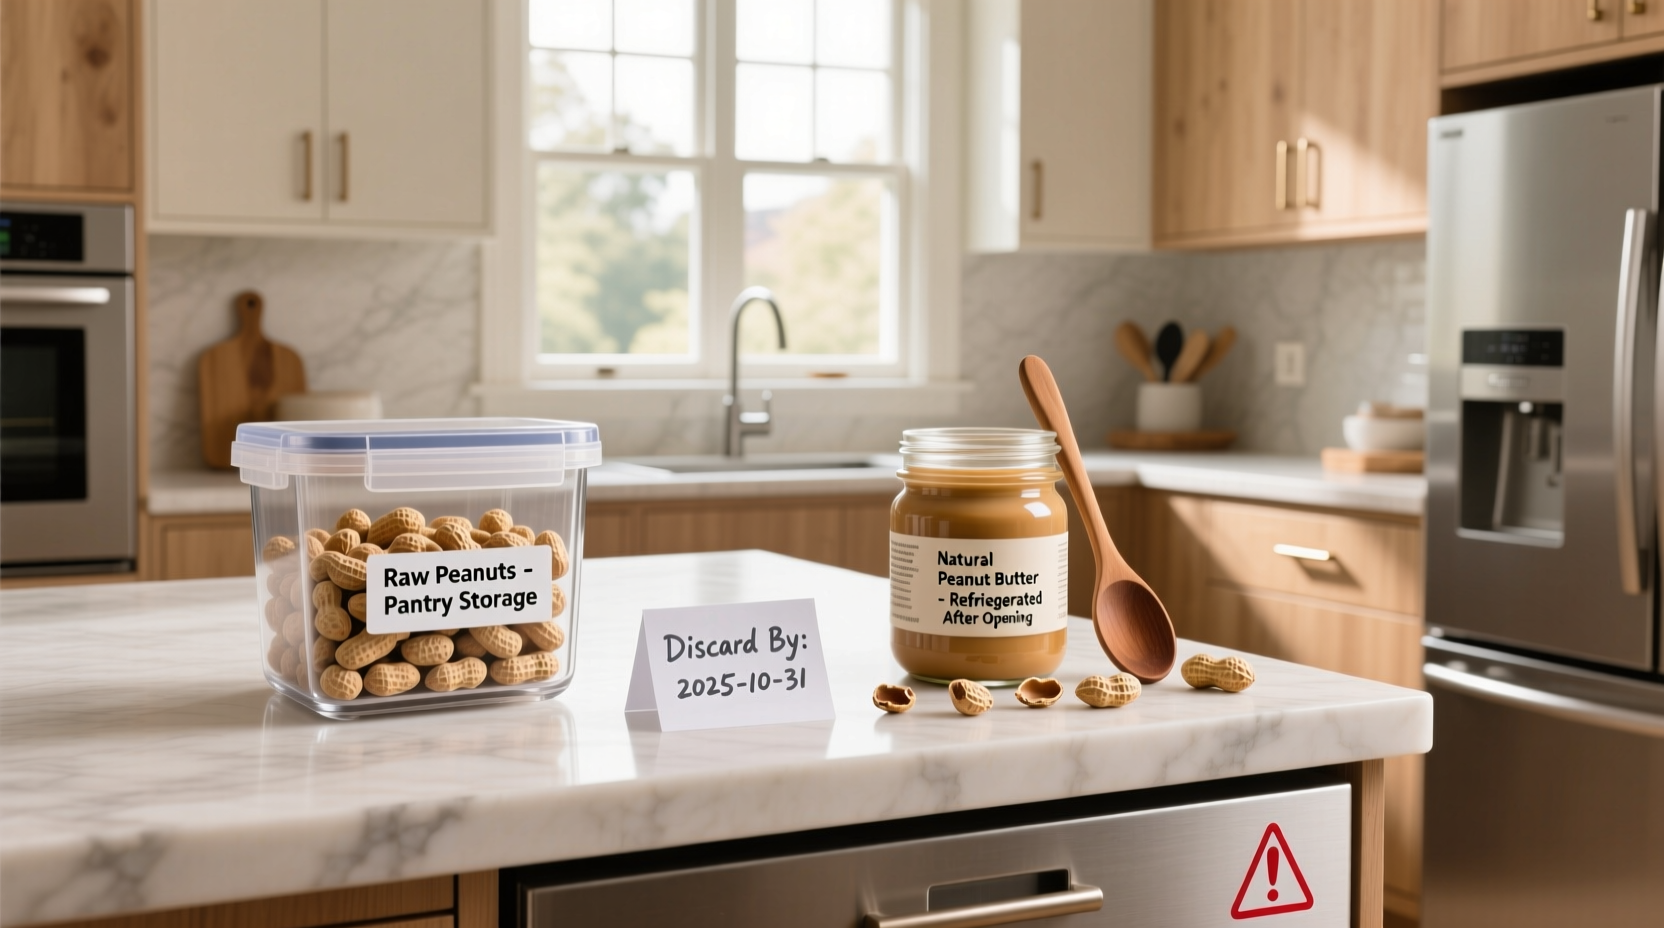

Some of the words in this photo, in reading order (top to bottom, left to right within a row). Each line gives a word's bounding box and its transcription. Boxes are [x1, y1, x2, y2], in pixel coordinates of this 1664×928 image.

[937, 550, 994, 567] Natural
[384, 567, 430, 588] Raw
[435, 562, 517, 585] Peanuts
[937, 570, 991, 587] Peanut
[994, 571, 1039, 587] Butter
[384, 594, 454, 618] Pantry
[459, 590, 538, 612] Storage
[942, 610, 980, 626] After
[663, 627, 759, 663] Discard
[768, 625, 808, 662] By:
[677, 667, 806, 700] 2025-10-31
